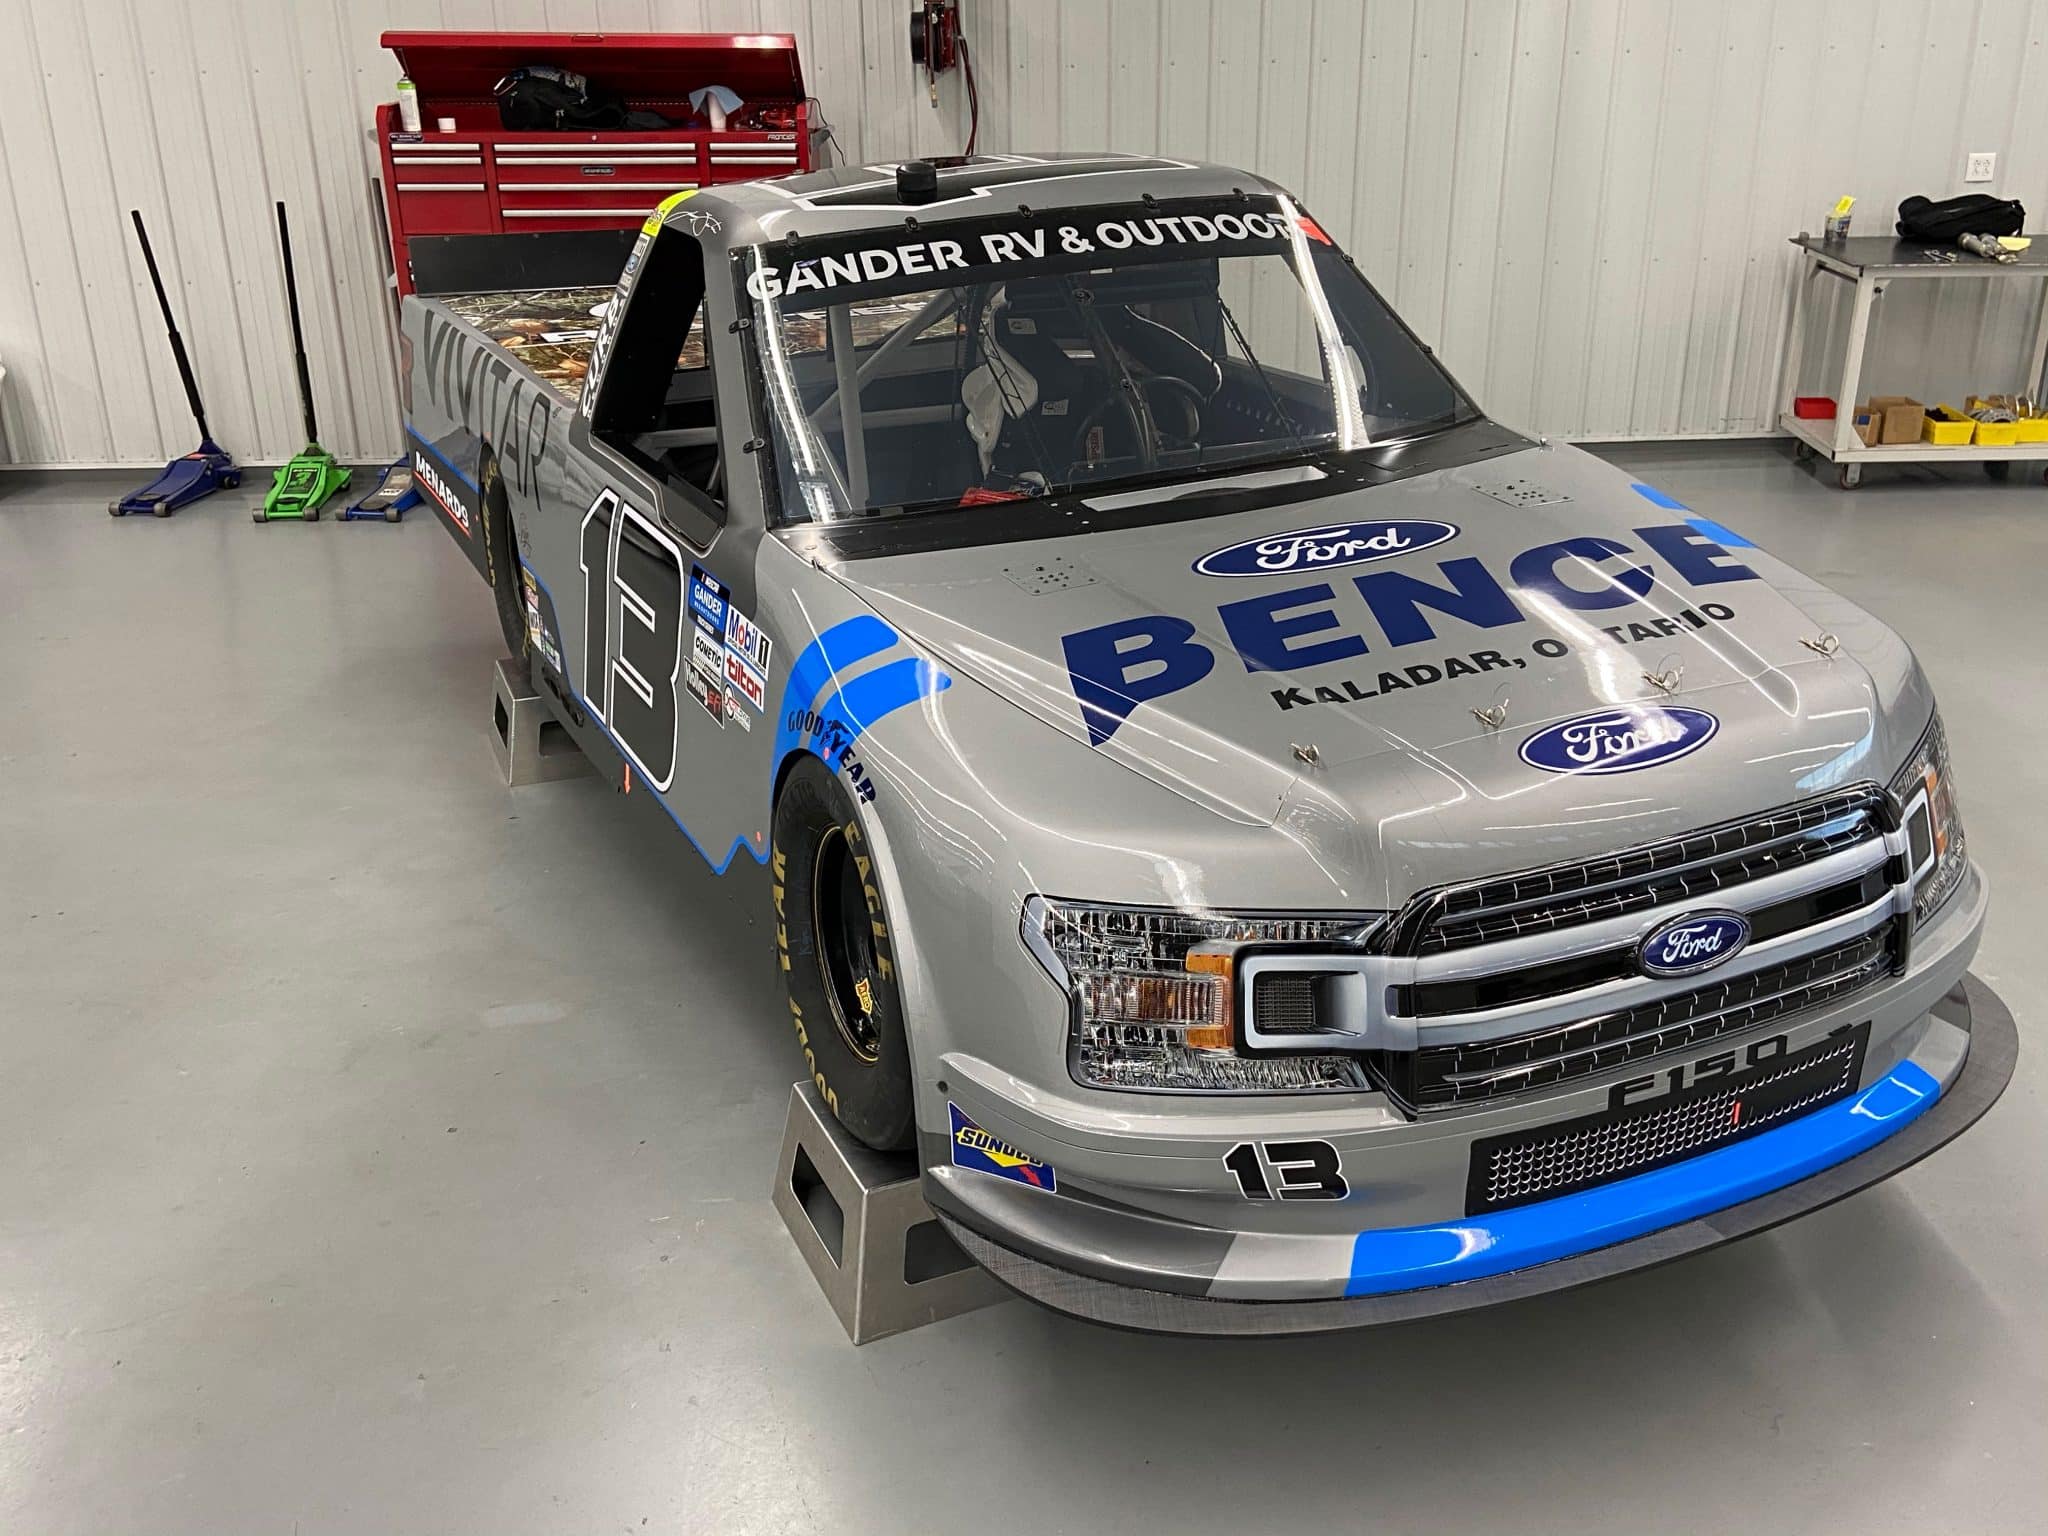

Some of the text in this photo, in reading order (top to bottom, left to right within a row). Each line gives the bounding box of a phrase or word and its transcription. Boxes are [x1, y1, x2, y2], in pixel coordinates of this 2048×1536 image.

[746, 239, 967, 300] GANDER
[984, 228, 1045, 264] RV
[1060, 226, 1096, 254] &
[423, 309, 551, 512] VIVITAR
[415, 450, 470, 528] MENARDS
[1255, 527, 1411, 570] Ford
[694, 584, 723, 617] GANDER
[1532, 603, 1735, 657] OTARIO
[580, 486, 684, 793] 13
[729, 607, 758, 659] Mobil
[1062, 524, 1762, 747] BENCE
[726, 653, 763, 707] tilton
[1270, 648, 1527, 711] KALADAR,
[844, 820, 894, 984] EAGLE
[1662, 923, 1722, 963] Ford
[1222, 1138, 1351, 1201] 13
